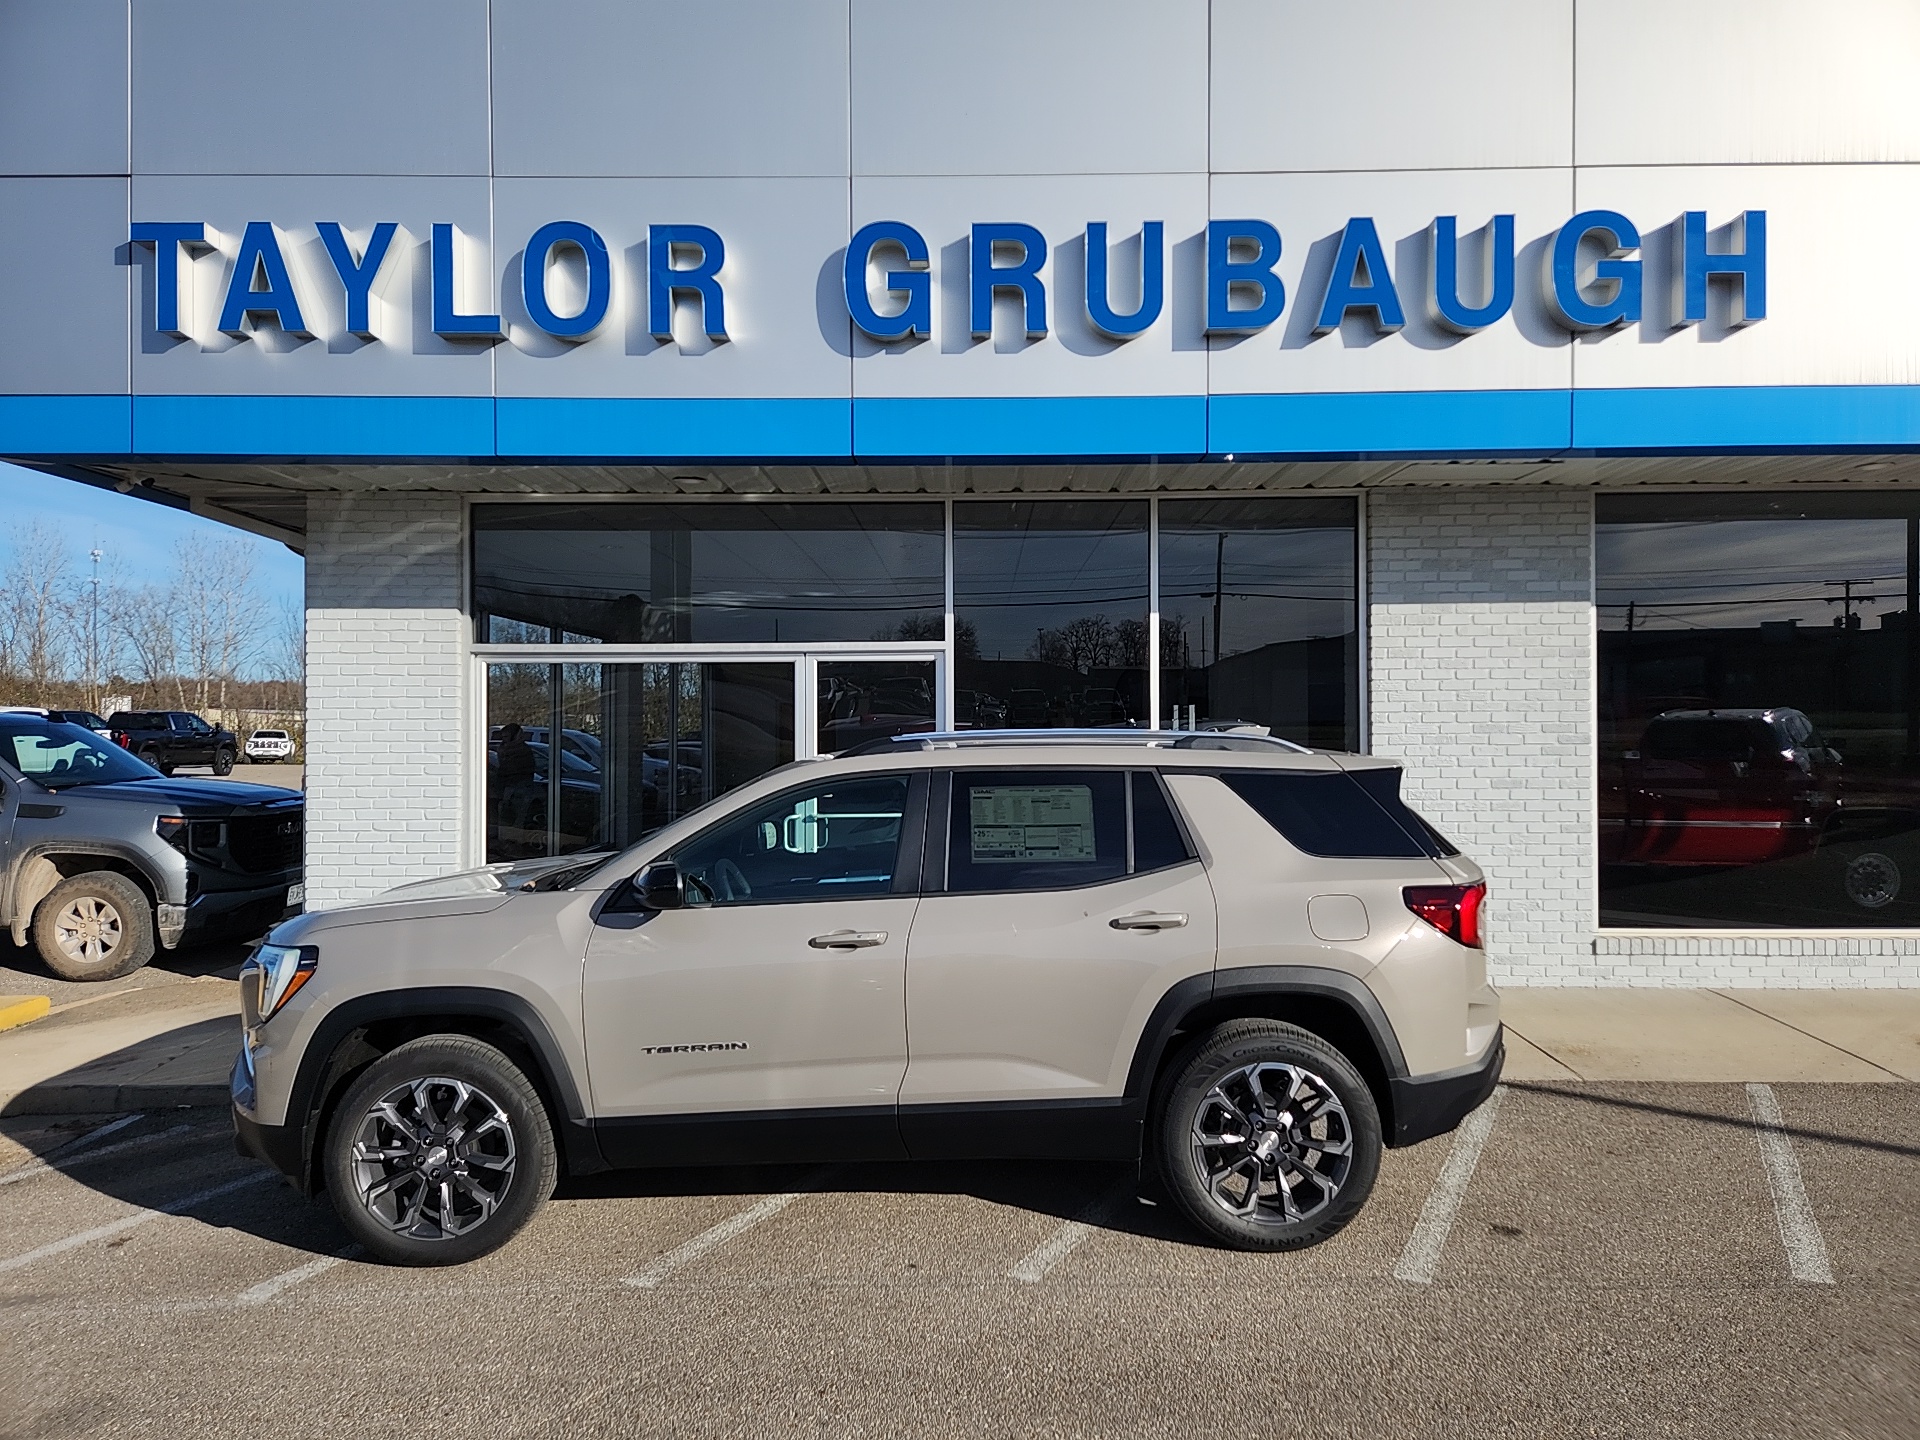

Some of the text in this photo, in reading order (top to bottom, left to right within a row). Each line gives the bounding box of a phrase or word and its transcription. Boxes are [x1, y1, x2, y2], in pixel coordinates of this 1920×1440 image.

[131, 210, 1767, 339] TAYLOR GRUBAUGH
[977, 830, 986, 838] 25
[641, 1042, 748, 1055] TERRAIN
